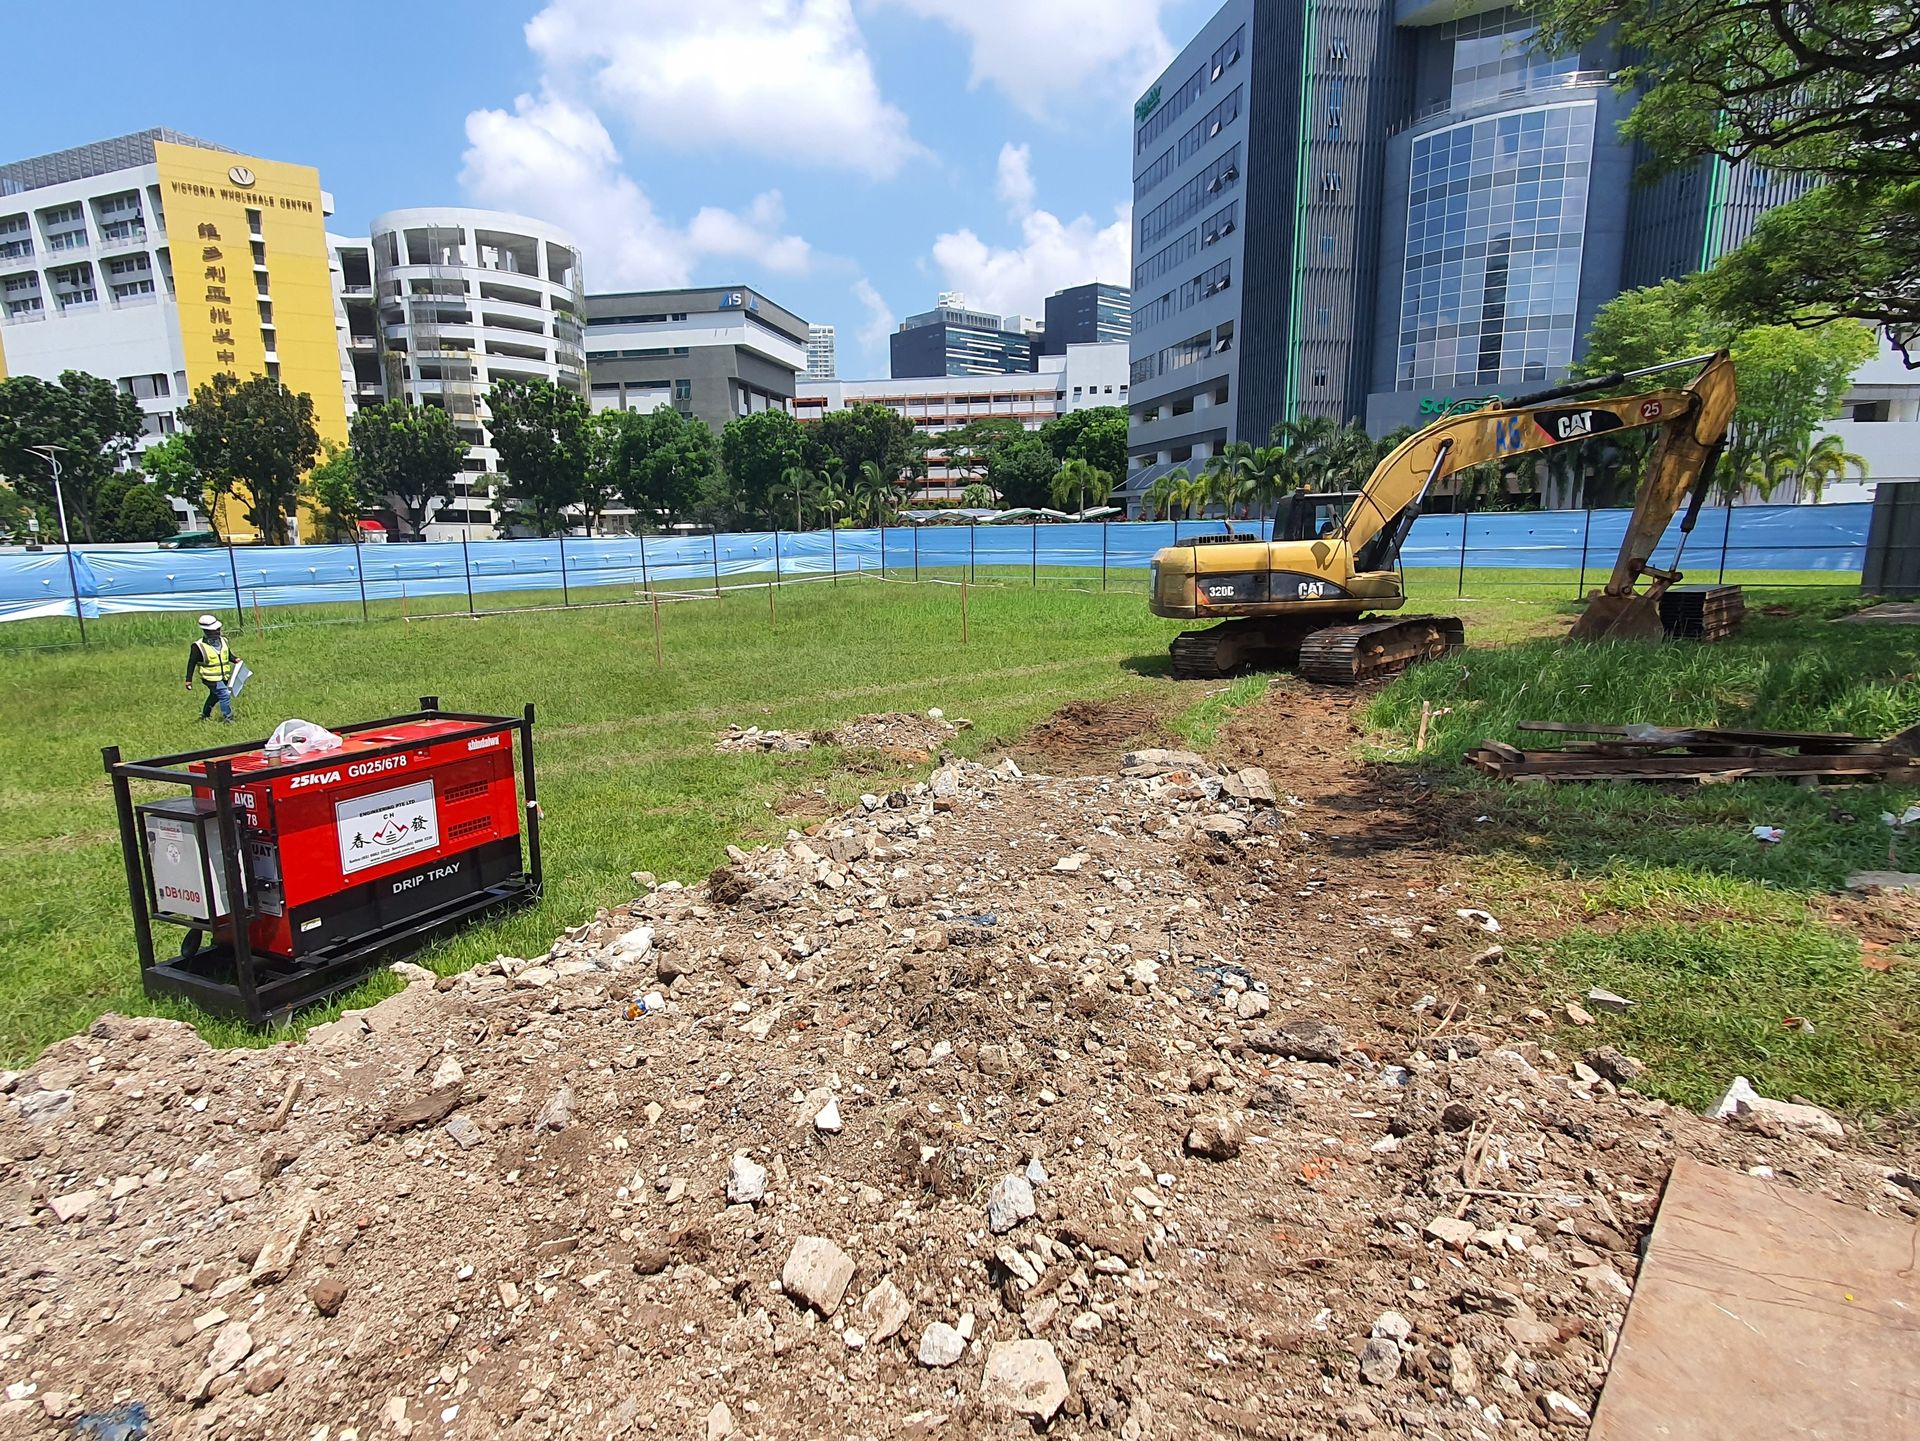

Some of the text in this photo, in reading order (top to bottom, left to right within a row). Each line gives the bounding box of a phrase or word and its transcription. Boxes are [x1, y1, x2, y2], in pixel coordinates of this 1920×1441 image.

[171, 181, 313, 213] VICTORIA WHOLESALE CENTRE
[1643, 402, 1660, 417] 25
[1557, 411, 1593, 438] CAT
[1298, 582, 1325, 598] CAT
[290, 755, 407, 788] 25kVA G025/678
[359, 804, 395, 818] ENGINEERING
[350, 832, 372, 850] 春
[393, 862, 461, 894] DRIP TRAY
[165, 886, 201, 903] DB1/309
